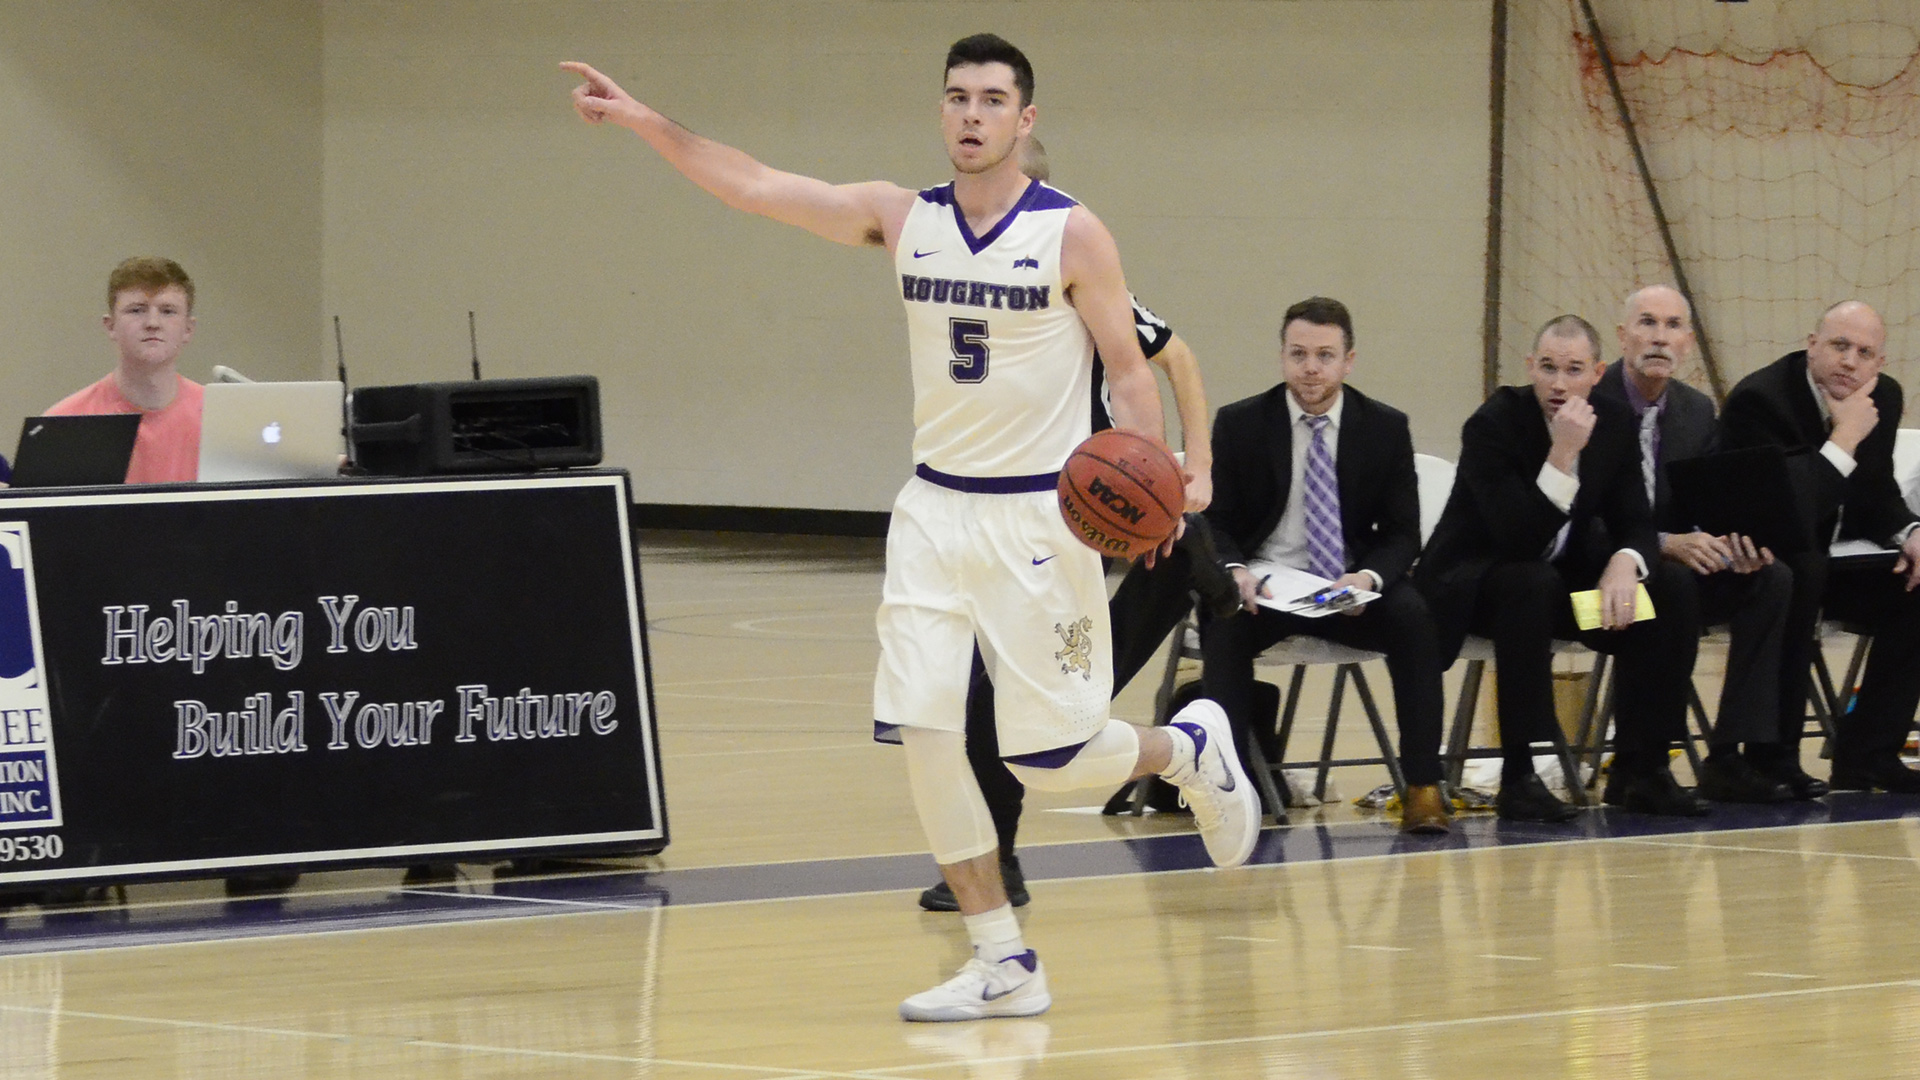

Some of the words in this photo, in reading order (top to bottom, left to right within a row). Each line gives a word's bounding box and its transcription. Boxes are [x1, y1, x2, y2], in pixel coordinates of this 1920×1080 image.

[902, 273, 1050, 312] HOUGHTON
[949, 317, 990, 384] 5
[1063, 495, 1130, 552] Wilson
[1088, 475, 1146, 525] NCAA
[101, 599, 304, 674] Helping
[318, 594, 419, 654] You
[172, 690, 308, 759] Build
[319, 690, 445, 750] Your
[455, 684, 619, 744] Future
[0, 789, 49, 814] INC.
[0, 834, 64, 862] 9530
